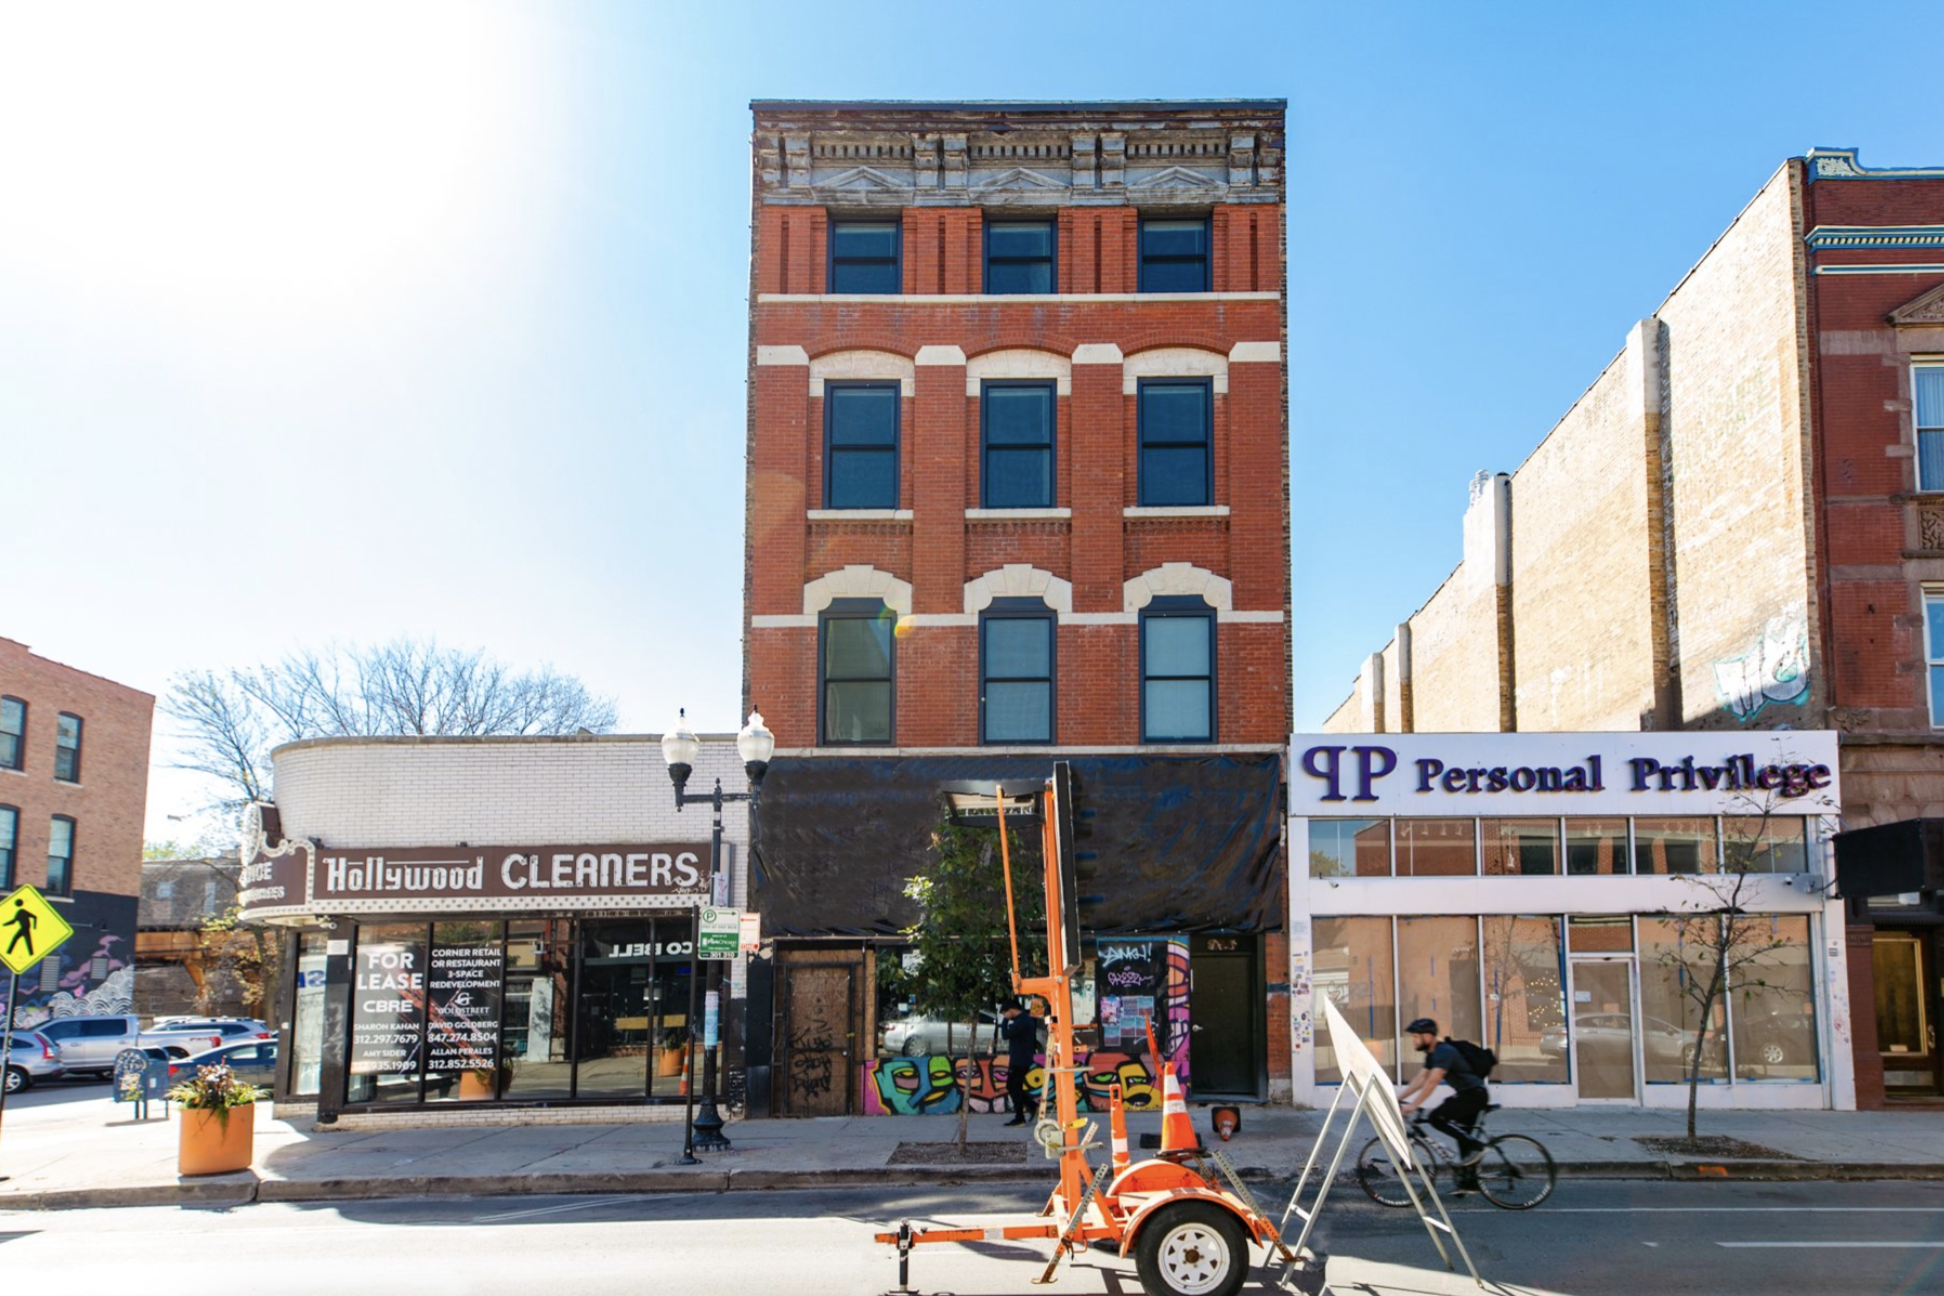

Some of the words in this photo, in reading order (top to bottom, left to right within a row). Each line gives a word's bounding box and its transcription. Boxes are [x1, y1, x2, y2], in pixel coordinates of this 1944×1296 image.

[1414, 754, 1606, 793] Personal
[1629, 753, 1832, 798] Privilege
[322, 855, 484, 893] Hollywood
[501, 852, 699, 889] CLEANERS
[431, 949, 471, 957] CORNER
[472, 948, 502, 956] RETAIL
[368, 952, 415, 970] FOR
[431, 960, 445, 968] OR
[446, 959, 501, 967] RESTAURANT
[447, 970, 484, 978] 3-SPACE
[357, 973, 423, 990] LEASE
[430, 980, 500, 988] REDEVELOPMENT
[362, 1000, 413, 1013] CBRE
[354, 1023, 389, 1031] SHARON
[390, 1022, 420, 1030] KAHAN
[427, 1021, 454, 1029] DAVID
[455, 1020, 498, 1028] GOLDBERG
[353, 1034, 418, 1044] 312.297.7679
[427, 1032, 498, 1043] 847.274.8504
[382, 1049, 407, 1057] SIDER
[430, 1047, 457, 1056] ALLAN
[459, 1047, 493, 1055] PERALES
[428, 1059, 494, 1070] 312.852.5526
